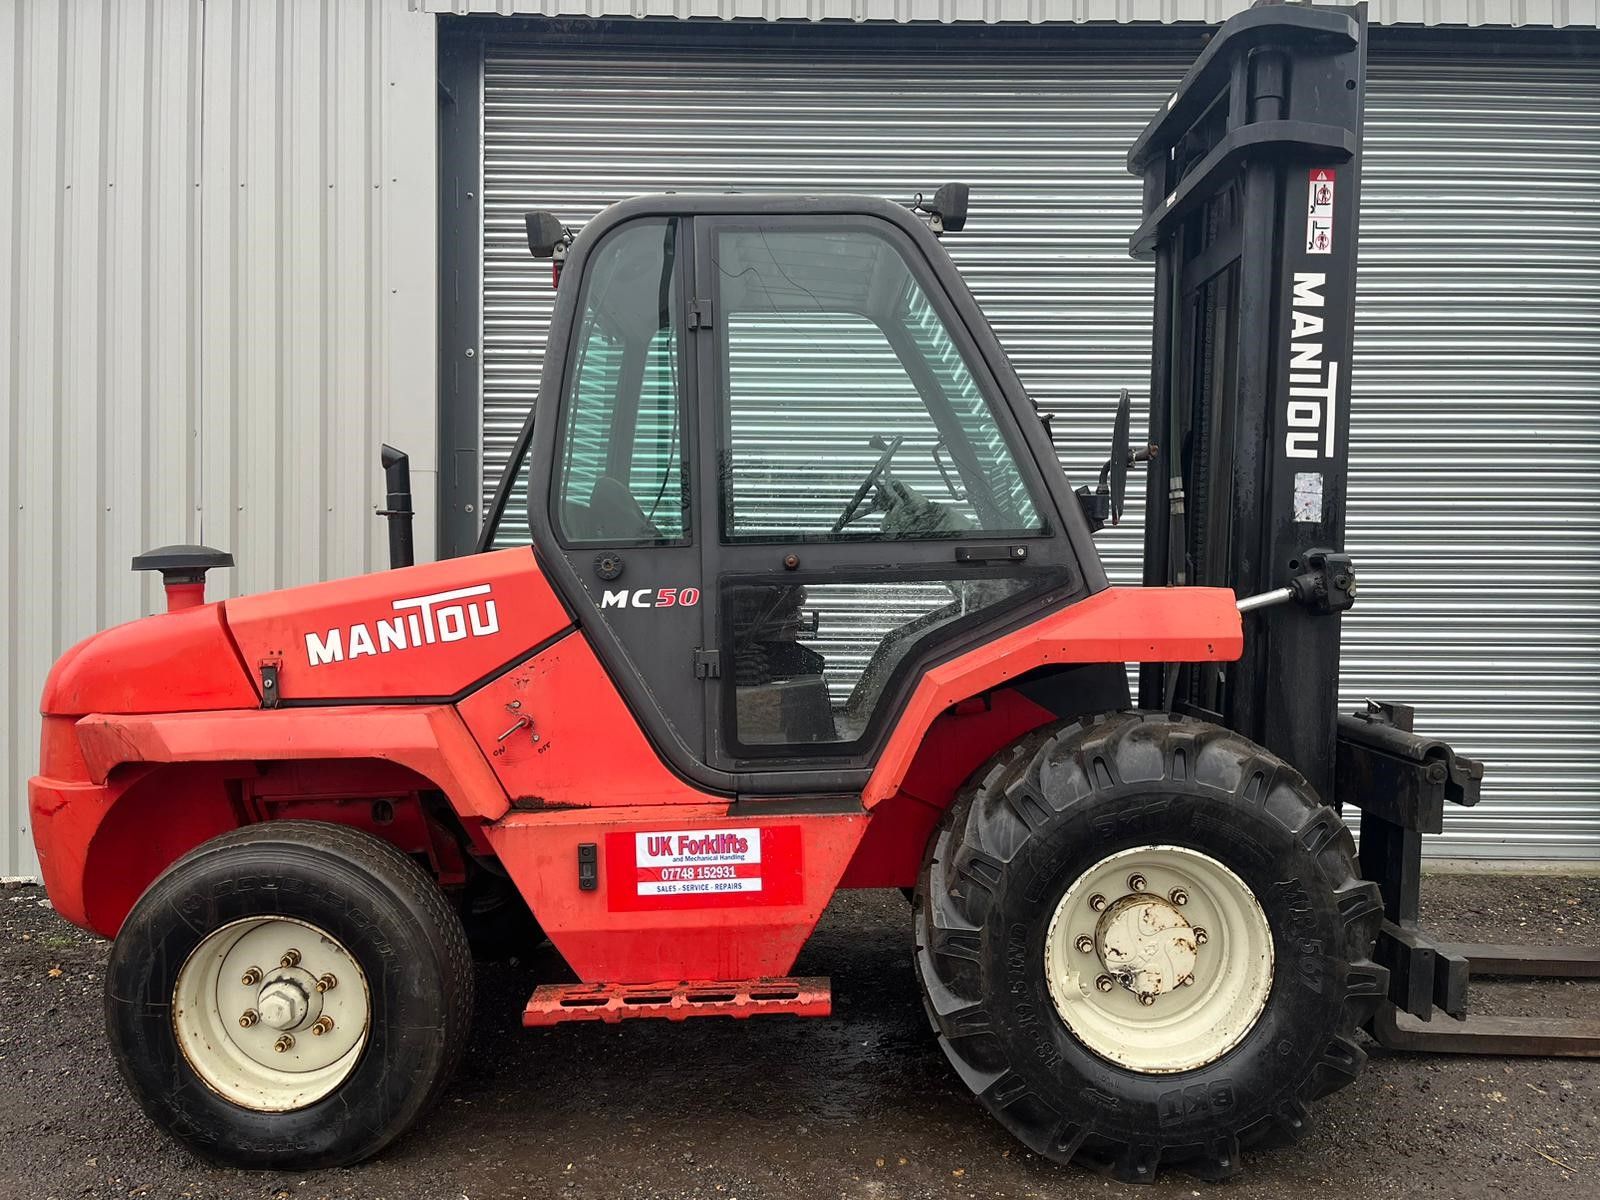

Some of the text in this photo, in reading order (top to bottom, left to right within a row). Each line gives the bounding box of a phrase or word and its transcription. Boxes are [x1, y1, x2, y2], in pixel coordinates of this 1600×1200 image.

[1284, 271, 1337, 459] MANITOU
[601, 588, 700, 609] MC50
[304, 583, 500, 667] MANITOU
[492, 746, 506, 757] ON
[647, 833, 749, 857] UK Forklifts
[684, 854, 719, 862] Mechanical
[719, 853, 745, 862] Handling
[661, 865, 737, 880] 07748 152931
[656, 884, 677, 893] SALES
[682, 882, 709, 892] SERVICE
[714, 881, 743, 891] REPAIRS
